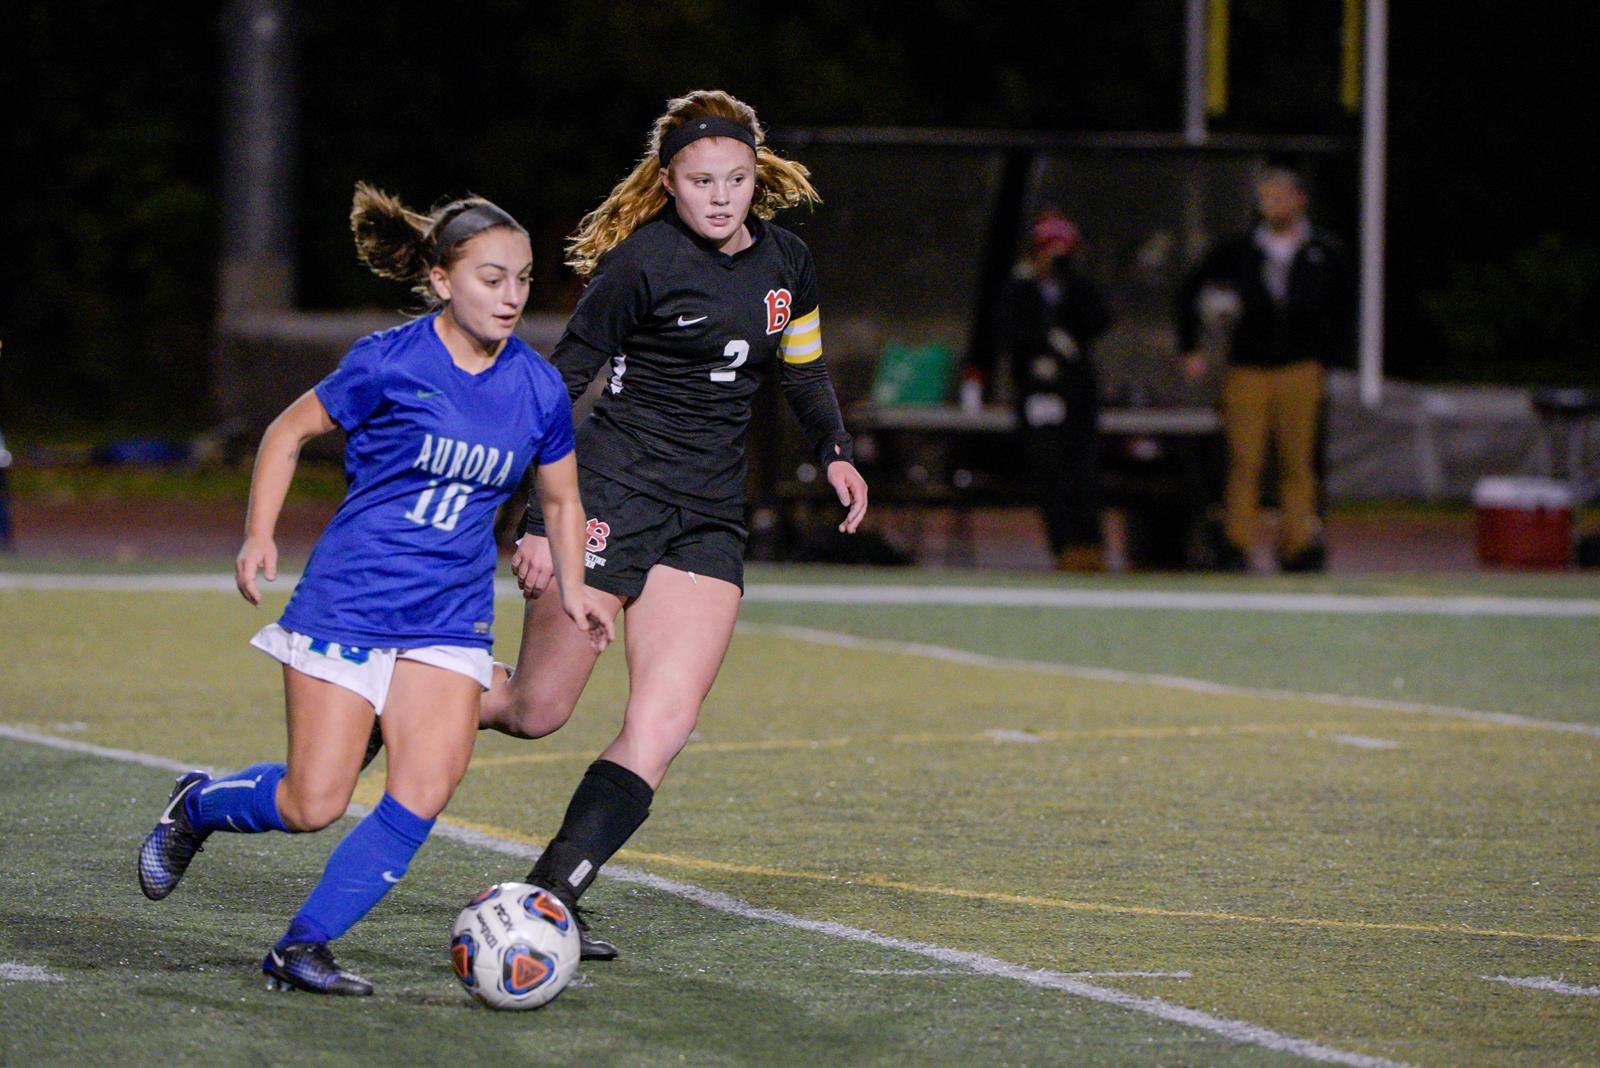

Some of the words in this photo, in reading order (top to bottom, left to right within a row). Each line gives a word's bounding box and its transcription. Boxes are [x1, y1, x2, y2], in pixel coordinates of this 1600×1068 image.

[764, 288, 792, 335] B
[710, 339, 750, 382] 2
[412, 433, 514, 487] AURORA
[404, 480, 474, 531] 10
